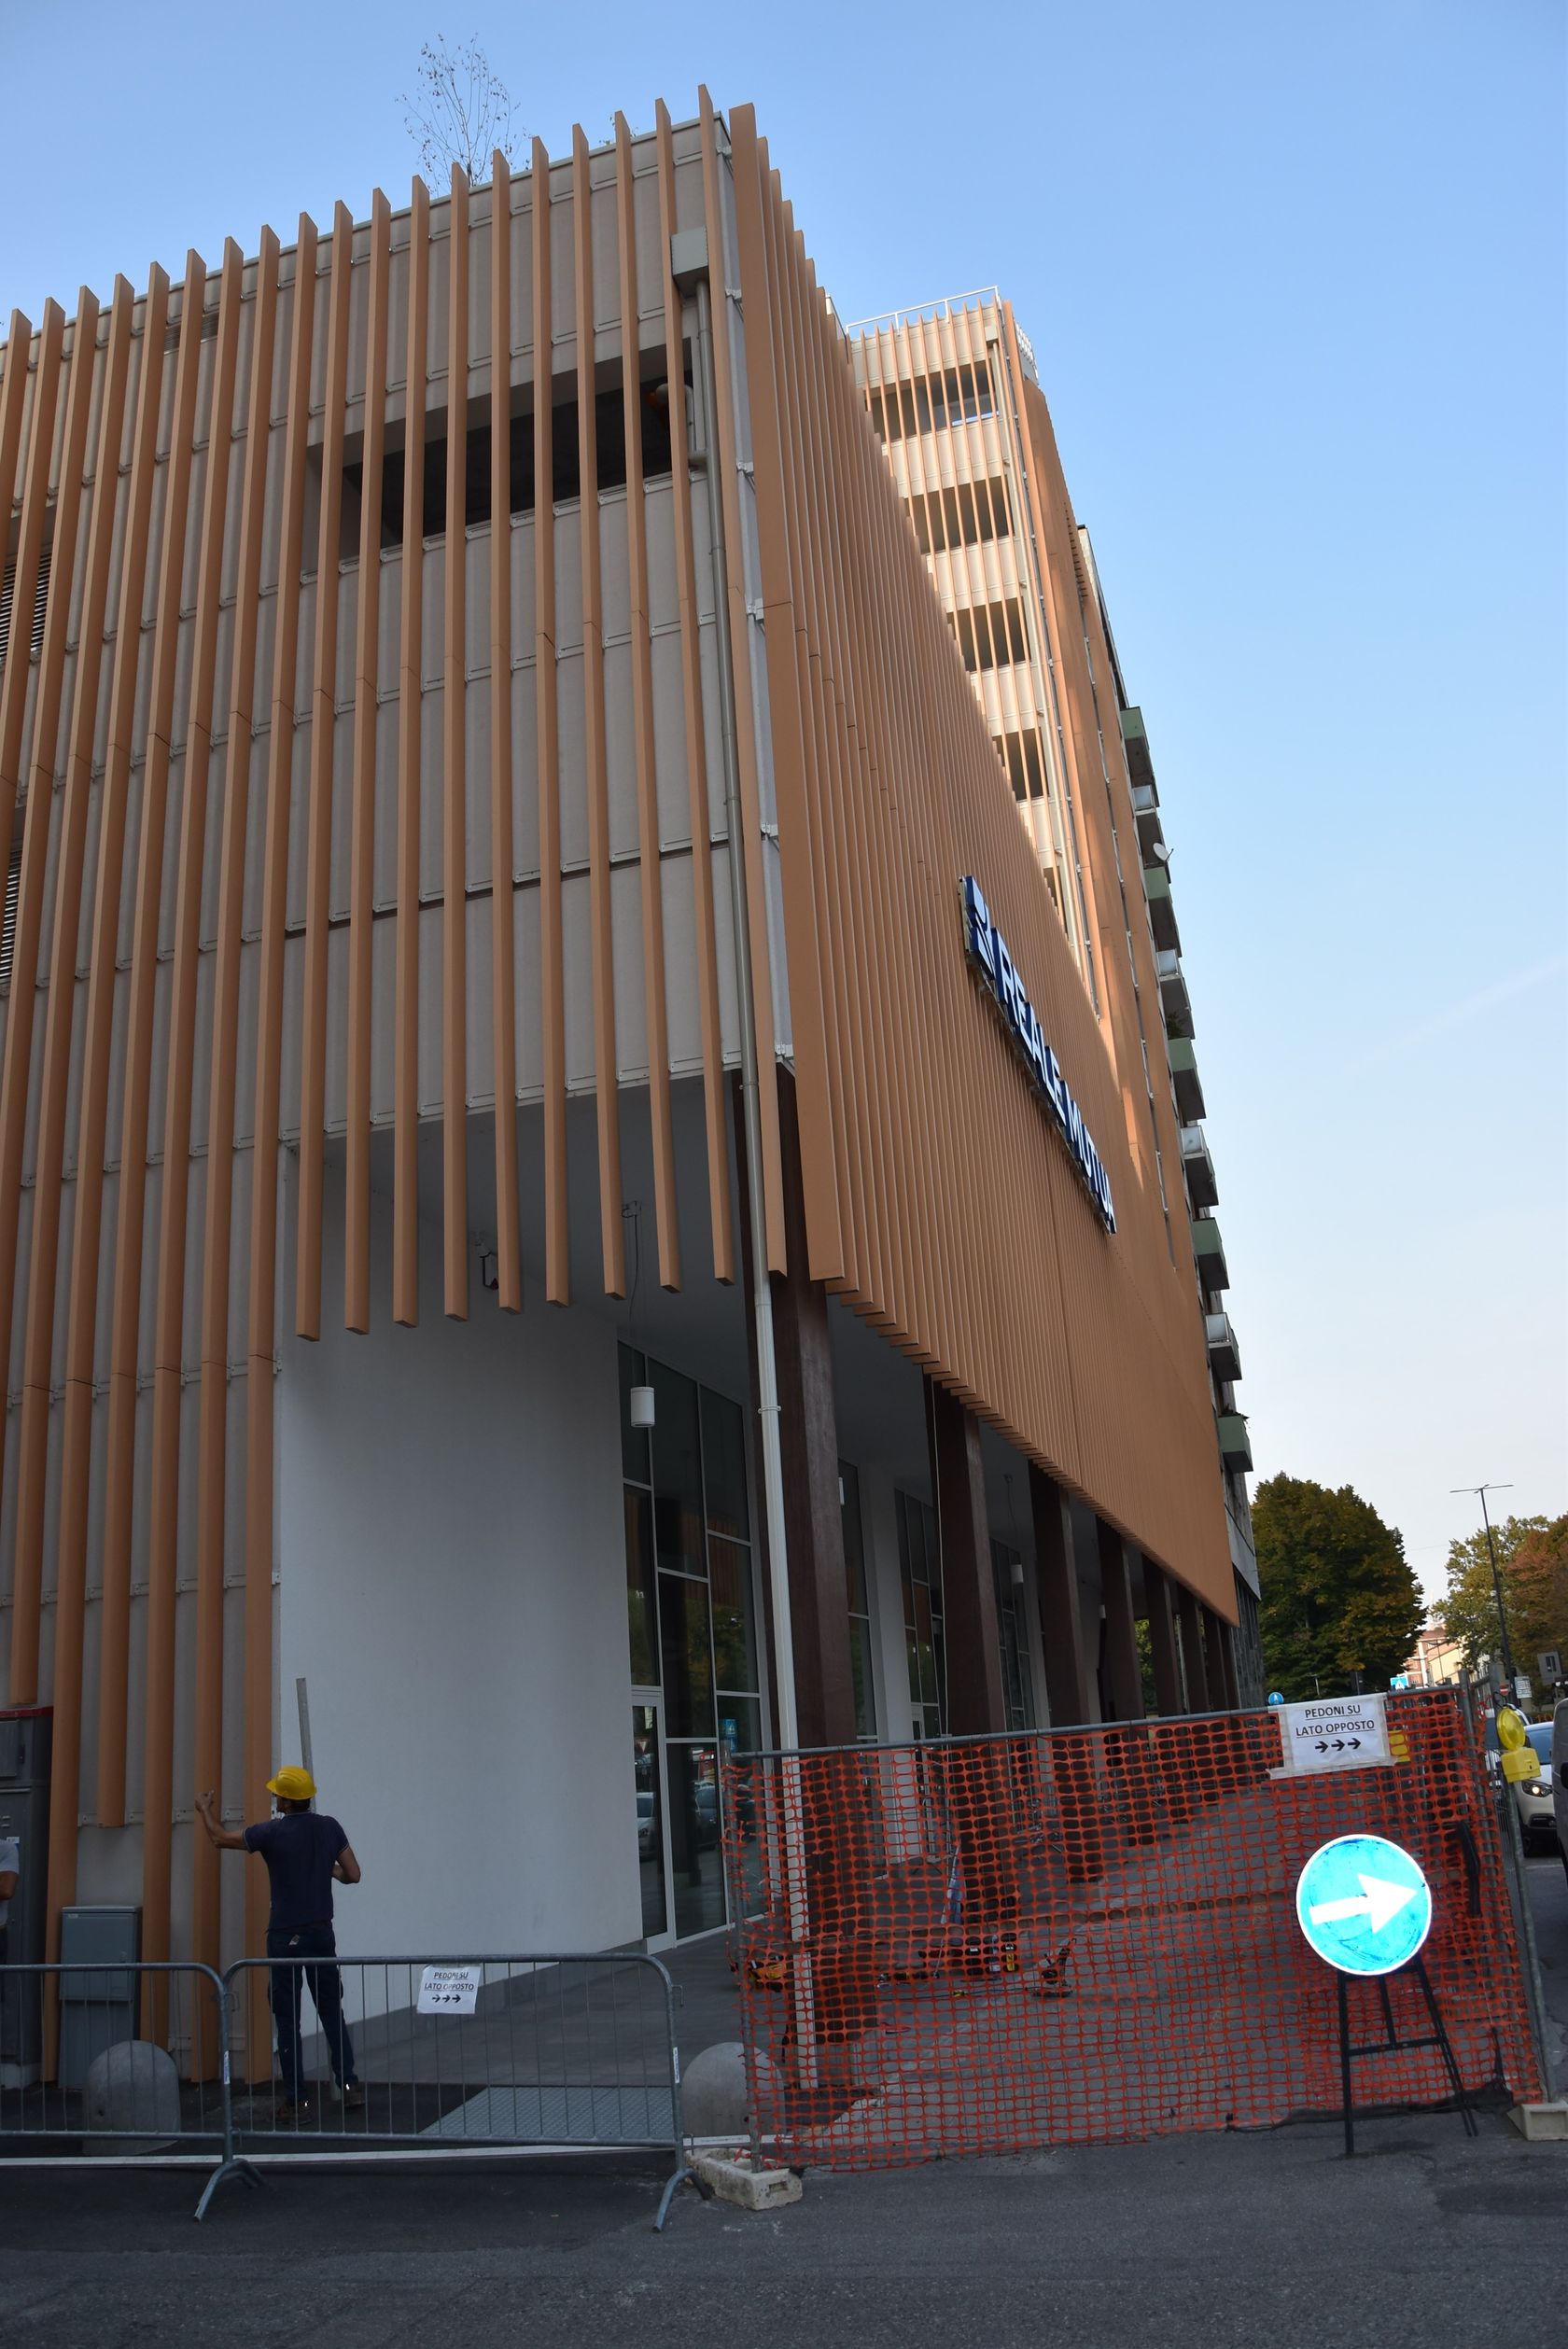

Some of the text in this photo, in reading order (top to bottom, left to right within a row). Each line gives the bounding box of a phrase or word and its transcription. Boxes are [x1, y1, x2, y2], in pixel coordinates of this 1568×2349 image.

[991, 927, 1117, 1234] REALE MUTUA
[1304, 1704, 1362, 1719] PEDONI SU
[1295, 1719, 1375, 1737] LATO OPPOSTO
[433, 1971, 459, 1979] PEDONI
[424, 1982, 475, 1991] LATO OPPOSTO
